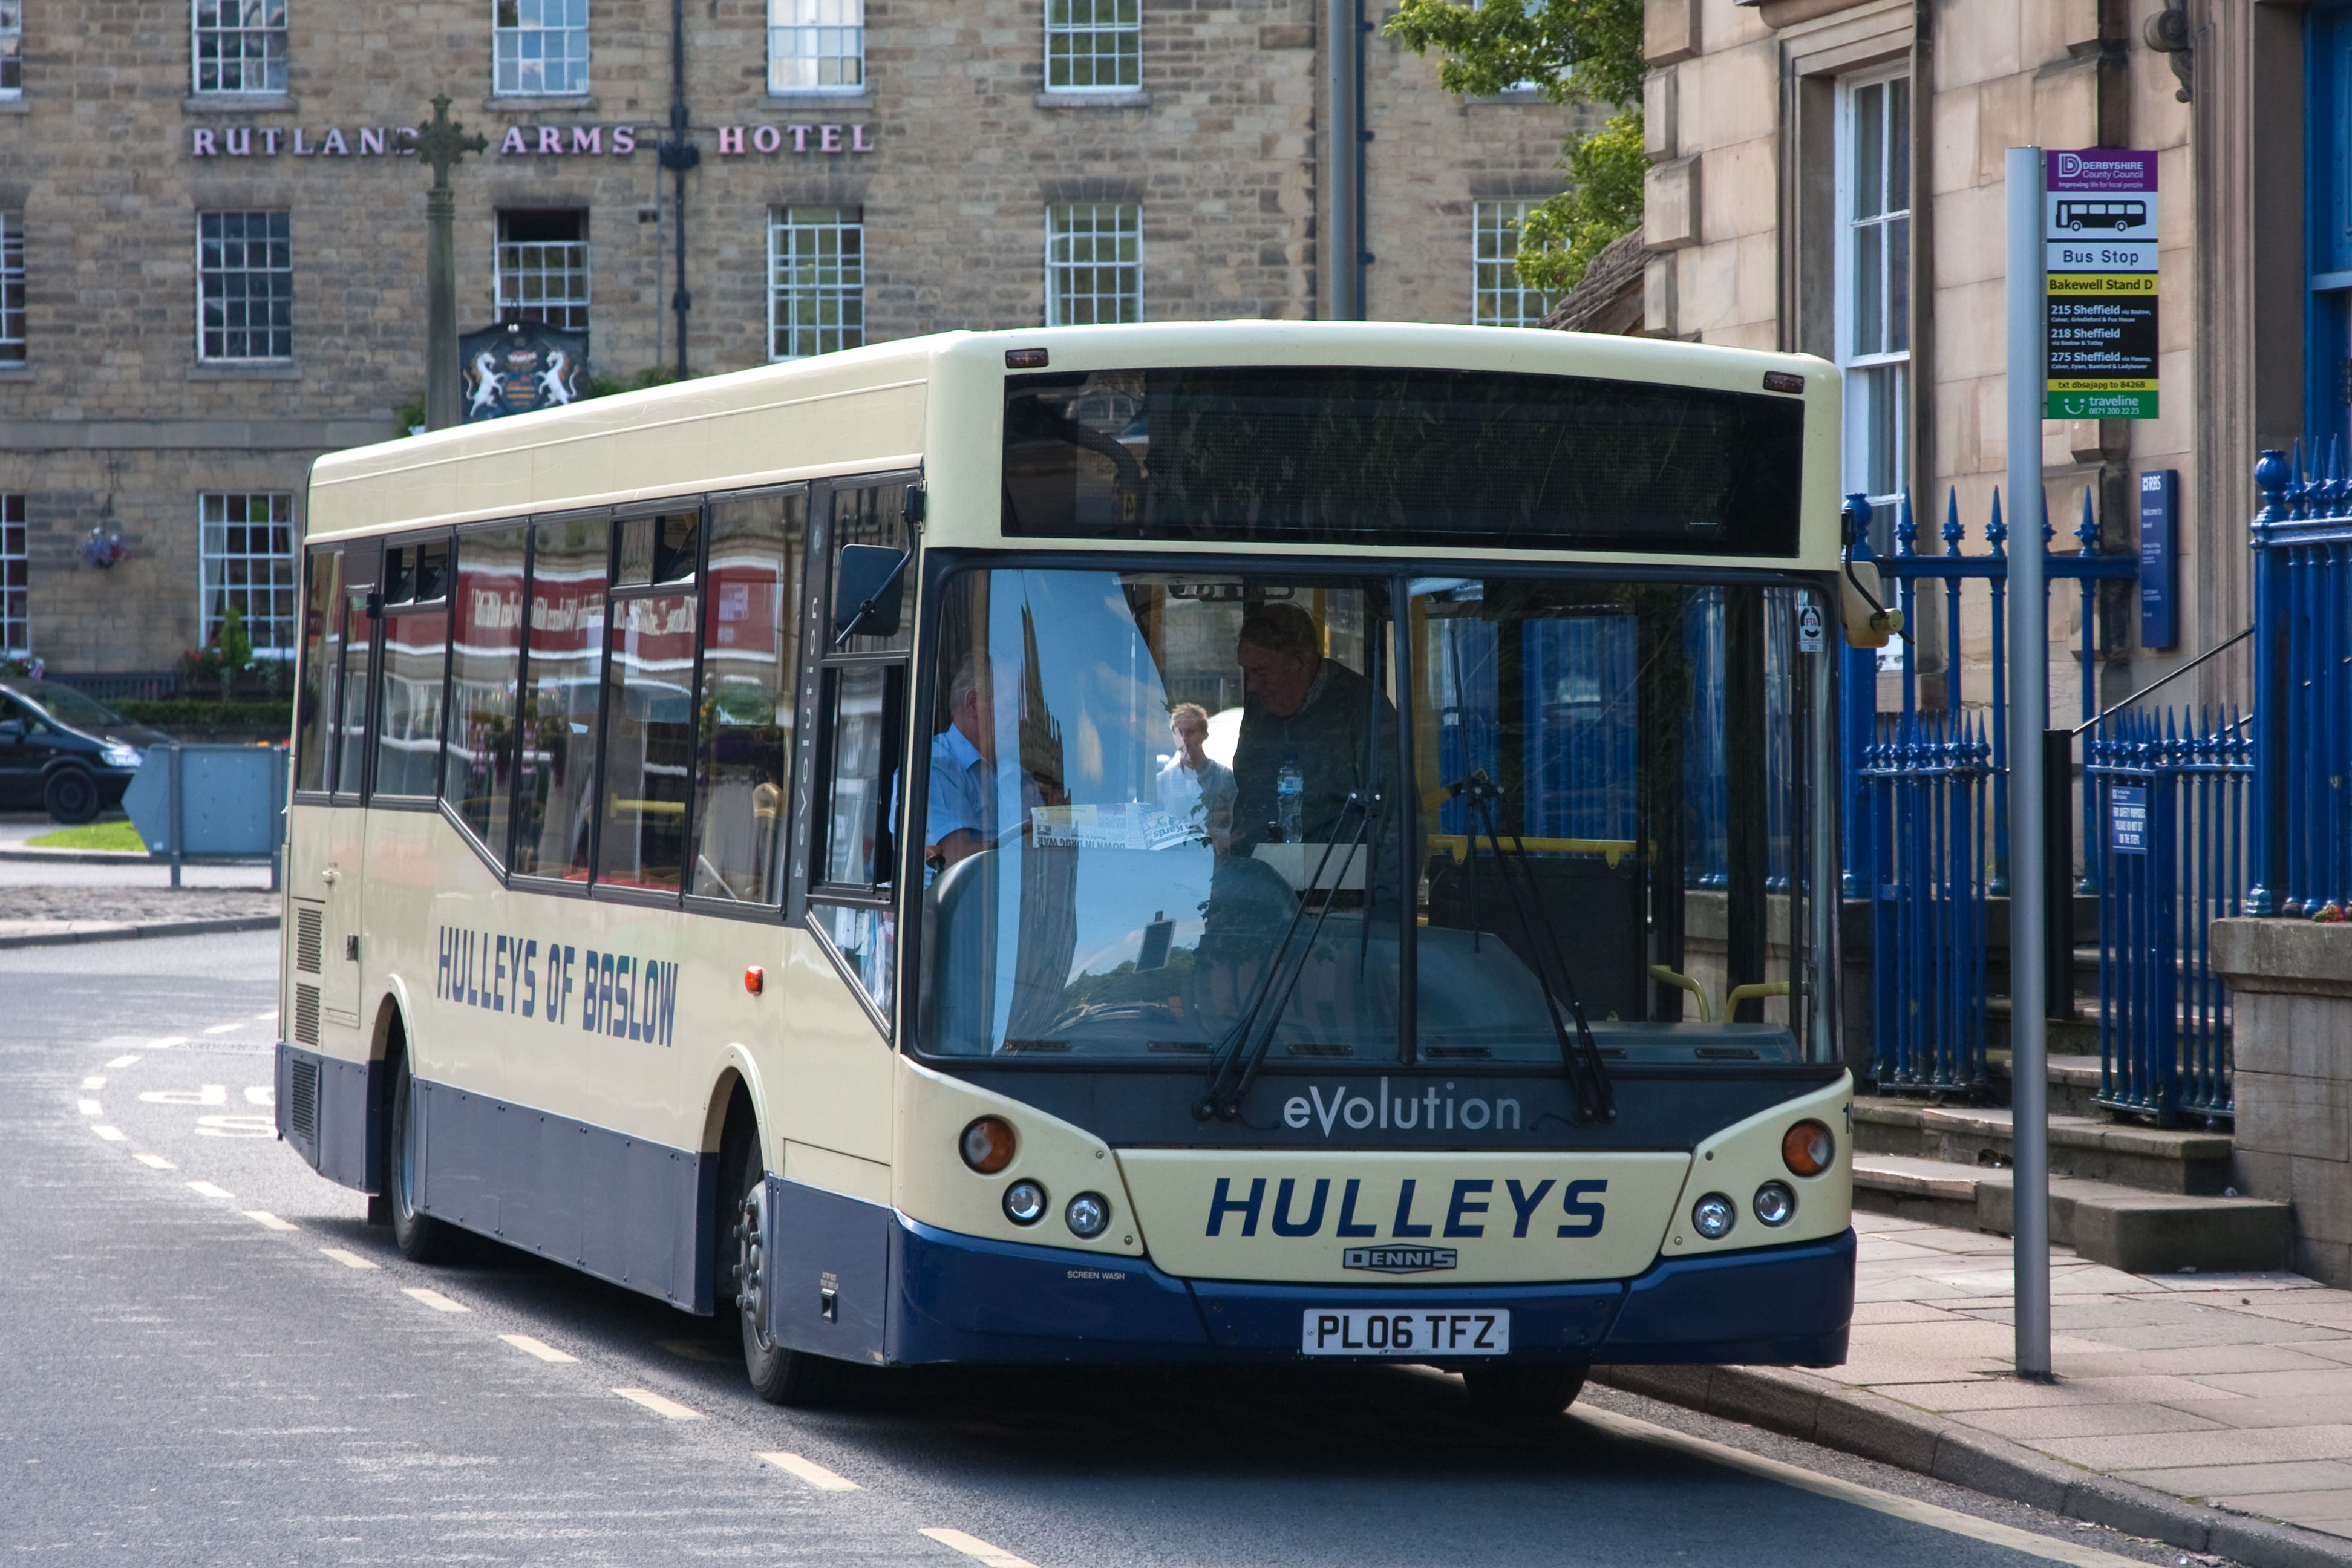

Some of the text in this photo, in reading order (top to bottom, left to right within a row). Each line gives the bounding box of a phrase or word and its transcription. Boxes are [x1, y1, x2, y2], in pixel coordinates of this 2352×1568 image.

[501, 125, 635, 154] ARMS
[717, 124, 874, 154] HOTEL
[2083, 170, 2143, 180] County Council
[2063, 250, 2139, 266] Bus Stop
[2050, 279, 2153, 290] Bakewell Stand D
[2051, 305, 2071, 315] 215
[2074, 305, 2120, 315] Sheffield
[2051, 328, 2120, 338] 218 Sheffield
[2051, 352, 2071, 362] 275
[2074, 352, 2120, 362] Sheffield
[2071, 381, 2108, 390] dbsajapg
[2089, 395, 2139, 406] traveline
[2149, 475, 2161, 491] RBS
[1806, 618, 1817, 626] FTA
[1037, 837, 1057, 847] WAR
[1059, 838, 1083, 848] DRUG
[437, 926, 678, 1048] HULLEYS OF BASLOW
[1283, 1076, 1521, 1138] eVolution
[1205, 1178, 1608, 1238] HULLEYS
[1344, 1250, 1456, 1267] DENNIS
[1067, 1270, 1125, 1281] SCREEN WASH
[1318, 1315, 1495, 1349] PL06 TFZ
